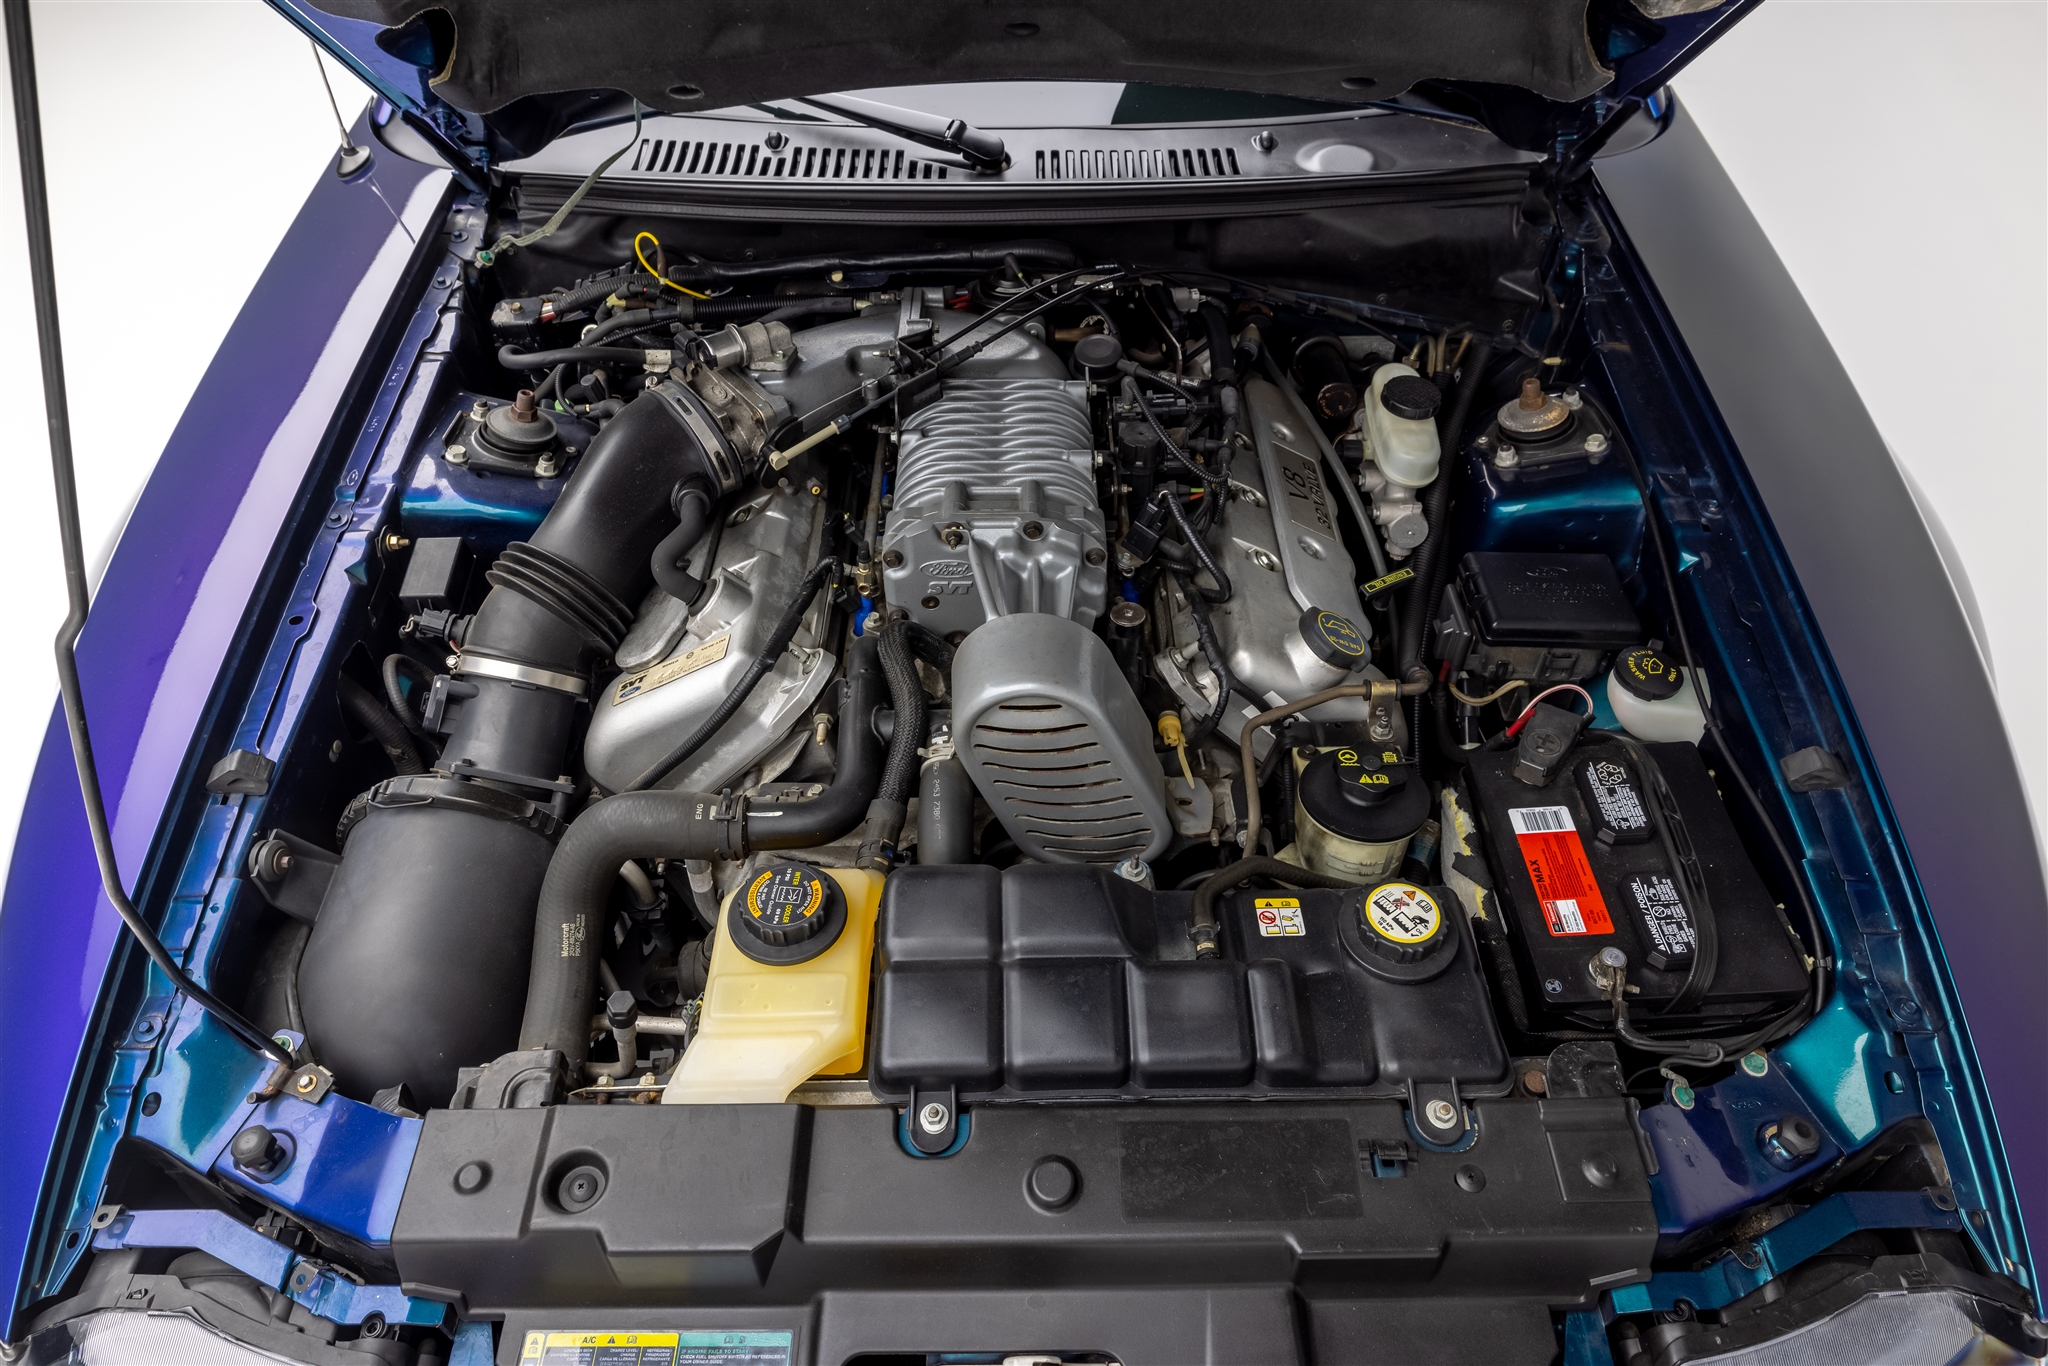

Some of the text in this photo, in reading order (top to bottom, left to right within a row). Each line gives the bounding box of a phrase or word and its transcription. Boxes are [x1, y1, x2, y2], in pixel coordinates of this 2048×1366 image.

[1282, 466, 1309, 500] V8
[1303, 463, 1331, 530] 32 VALVE
[929, 561, 968, 576] Ford
[927, 580, 973, 596] SVT
[1628, 657, 1645, 680] WASHER
[1668, 667, 1676, 682] ONLY
[619, 675, 648, 691] SVT
[695, 804, 703, 819] ENG
[1529, 857, 1545, 884] MAX
[749, 876, 766, 915] AVERTISSEMENT
[783, 872, 801, 923] INTER COOLER
[807, 888, 820, 913] WARNING
[1631, 883, 1647, 908] POISON
[1386, 922, 1395, 930] kPa
[1415, 927, 1423, 935] OK
[1645, 915, 1662, 944] DANGER
[561, 923, 569, 956] Motorcraft
[582, 1336, 597, 1344] A/C
